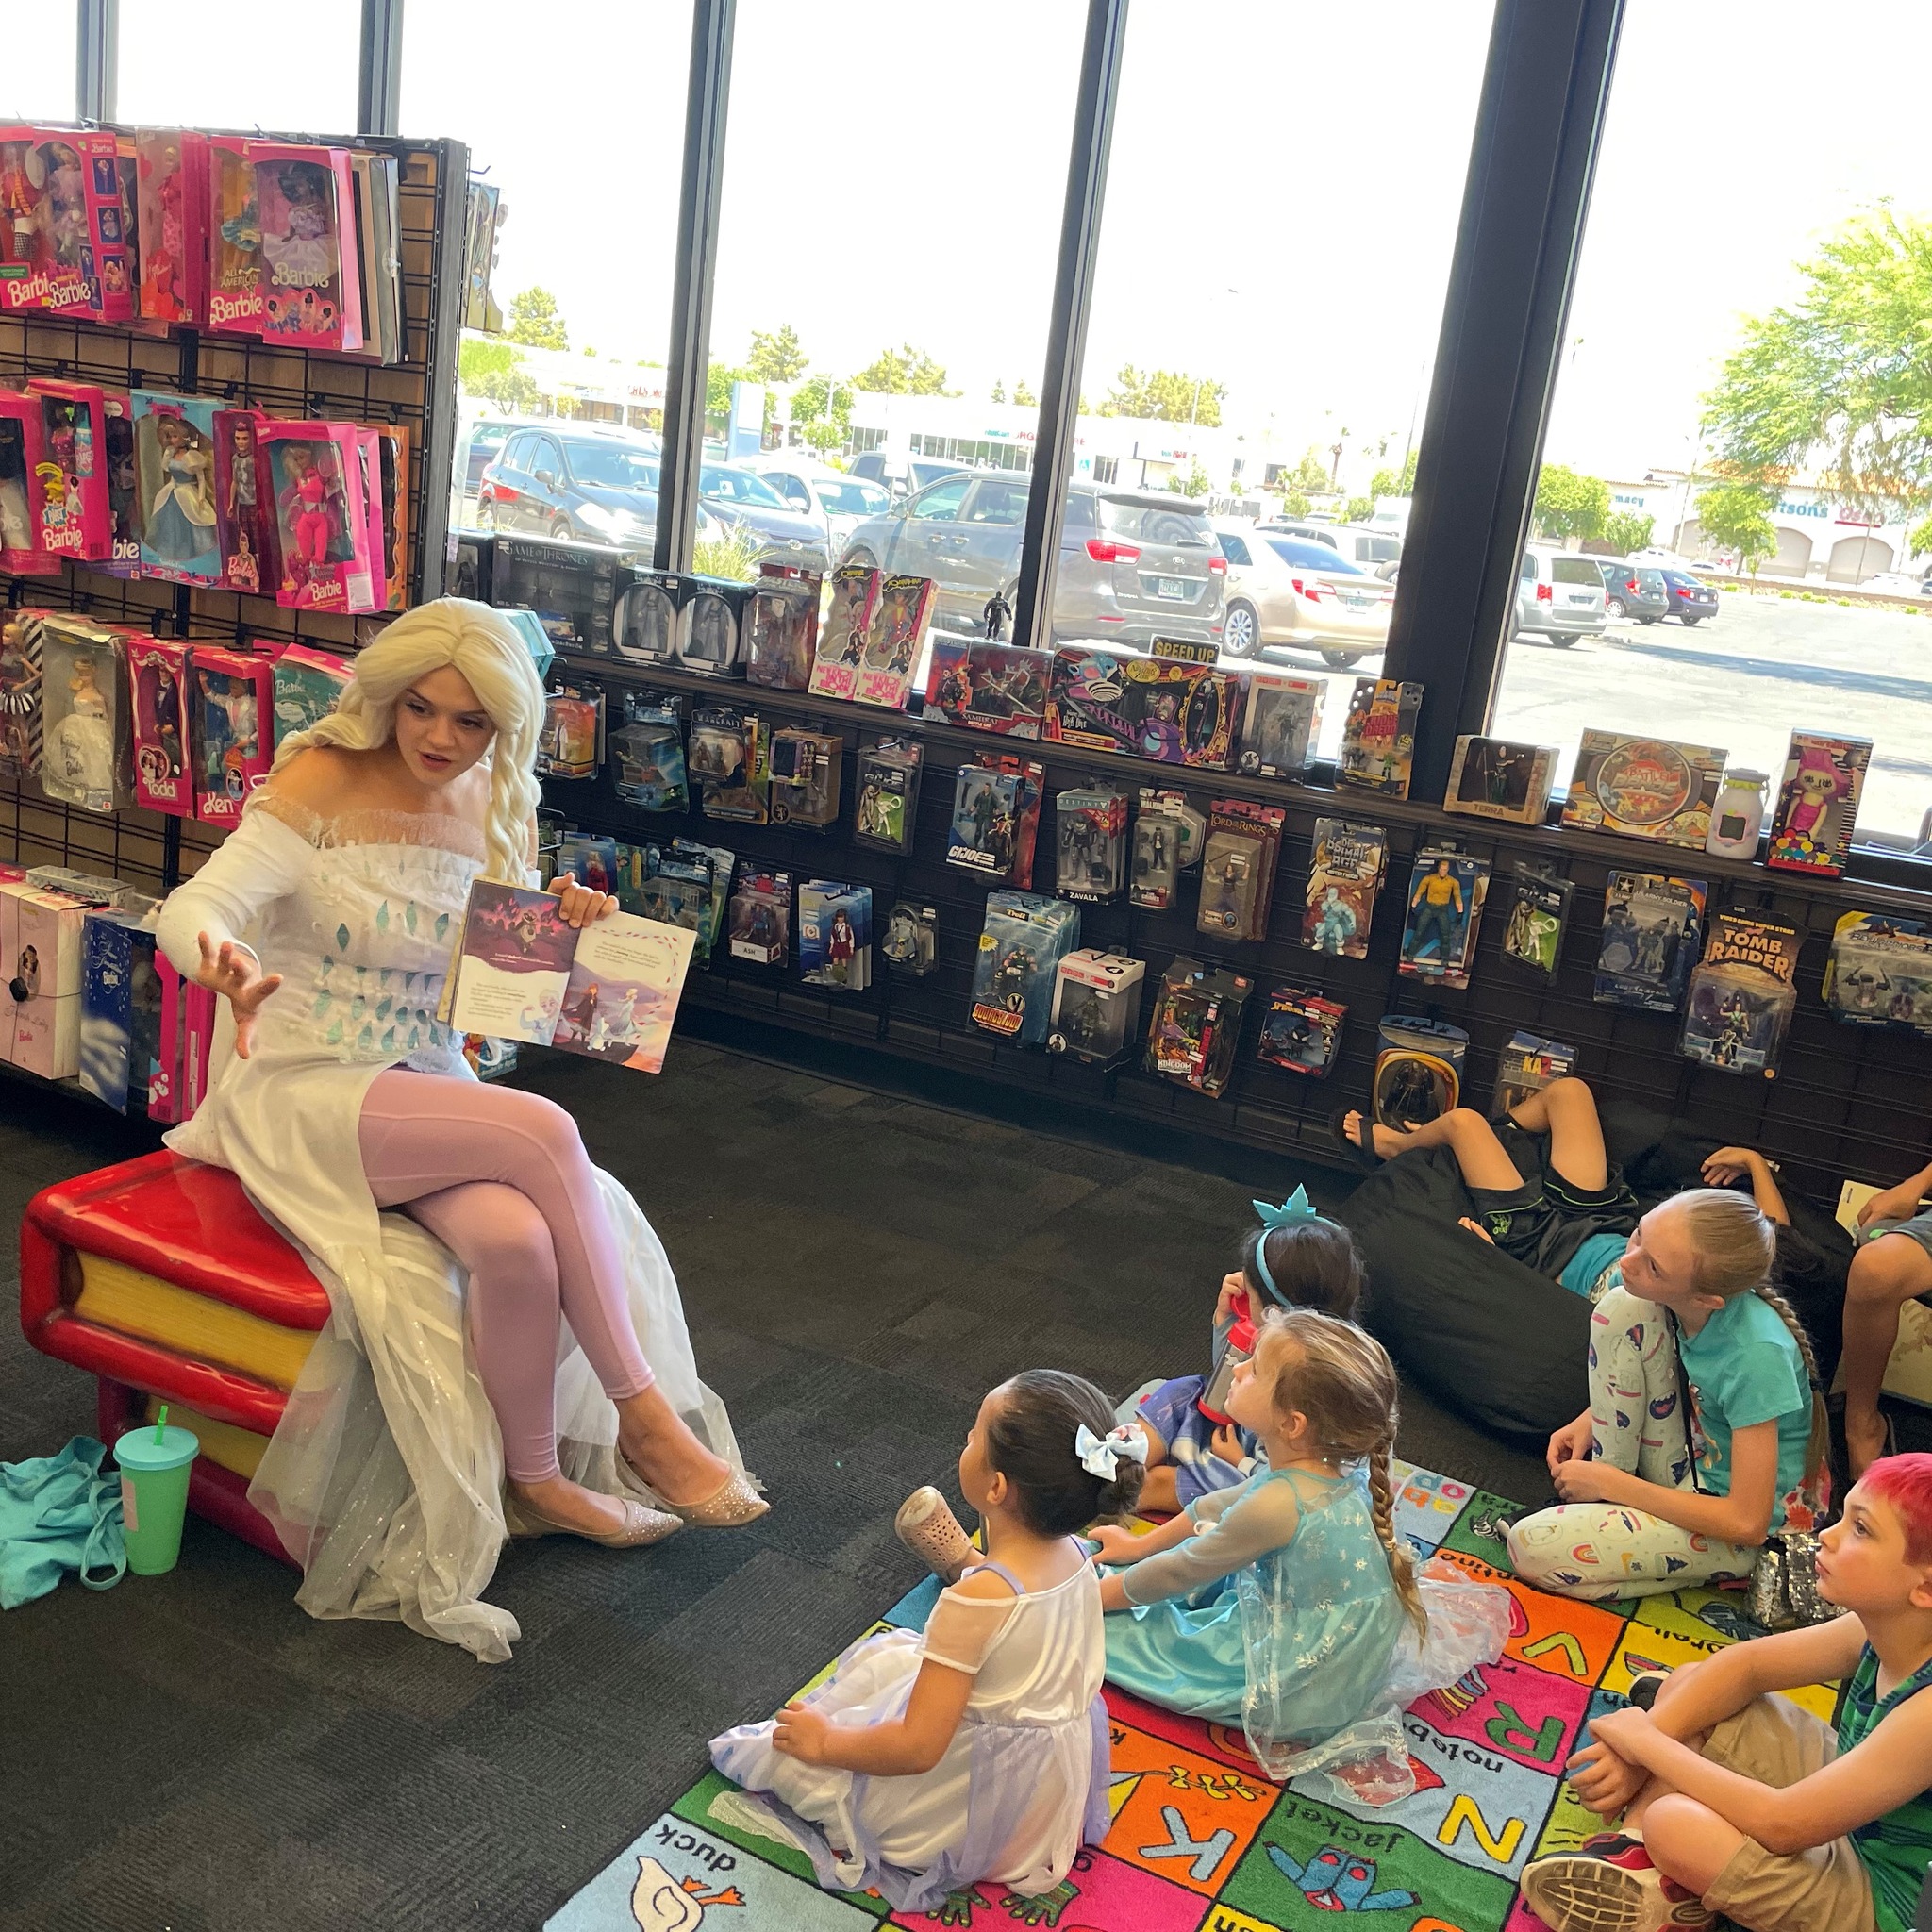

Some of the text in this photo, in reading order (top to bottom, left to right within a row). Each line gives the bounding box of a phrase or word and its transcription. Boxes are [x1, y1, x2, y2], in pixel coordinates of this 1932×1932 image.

[221, 273, 258, 289] AMERICAN
[225, 269, 238, 277] ALL
[271, 262, 329, 289] Barbie
[8, 273, 49, 308] Barbi
[49, 282, 91, 309] Barbie
[209, 294, 262, 325] Barbie
[1615, 493, 1644, 508] macy
[42, 527, 83, 551] Barbie
[112, 539, 140, 560] bie
[541, 546, 590, 566] THRONES
[311, 579, 342, 601] Barbie
[1155, 641, 1216, 663] SPEED UP
[697, 713, 740, 728] WARCRAFT
[1365, 724, 1396, 736] DREDD
[1368, 715, 1398, 726] JUDGE
[1629, 766, 1669, 781] BATTLE
[142, 777, 176, 798] Todd
[203, 791, 234, 814] Ken
[1059, 799, 1098, 808] DESTINY
[1474, 804, 1504, 816] TERRA
[1210, 813, 1266, 837] LORD RINGS
[1326, 838, 1366, 860] PRIMAL
[1332, 855, 1358, 869] AGE
[1069, 891, 1098, 902] ZAVALA
[1663, 896, 1689, 908] SOLDIER
[1007, 908, 1026, 920] Troll
[1737, 918, 1755, 926] GAME
[1755, 922, 1774, 931] SUPER
[743, 947, 755, 956] ASH
[1724, 928, 1783, 954] TOMB
[1709, 942, 1790, 980] RAIDER
[1158, 1058, 1191, 1069] KINGDOM
[1521, 1630, 1589, 1676] V
[1484, 1699, 1567, 1764] R
[1404, 1723, 1504, 1774] noteb
[1284, 1796, 1406, 1855] jacket
[1436, 1793, 1527, 1863] N
[655, 1820, 738, 1874] duck
[1138, 1804, 1235, 1883] K
